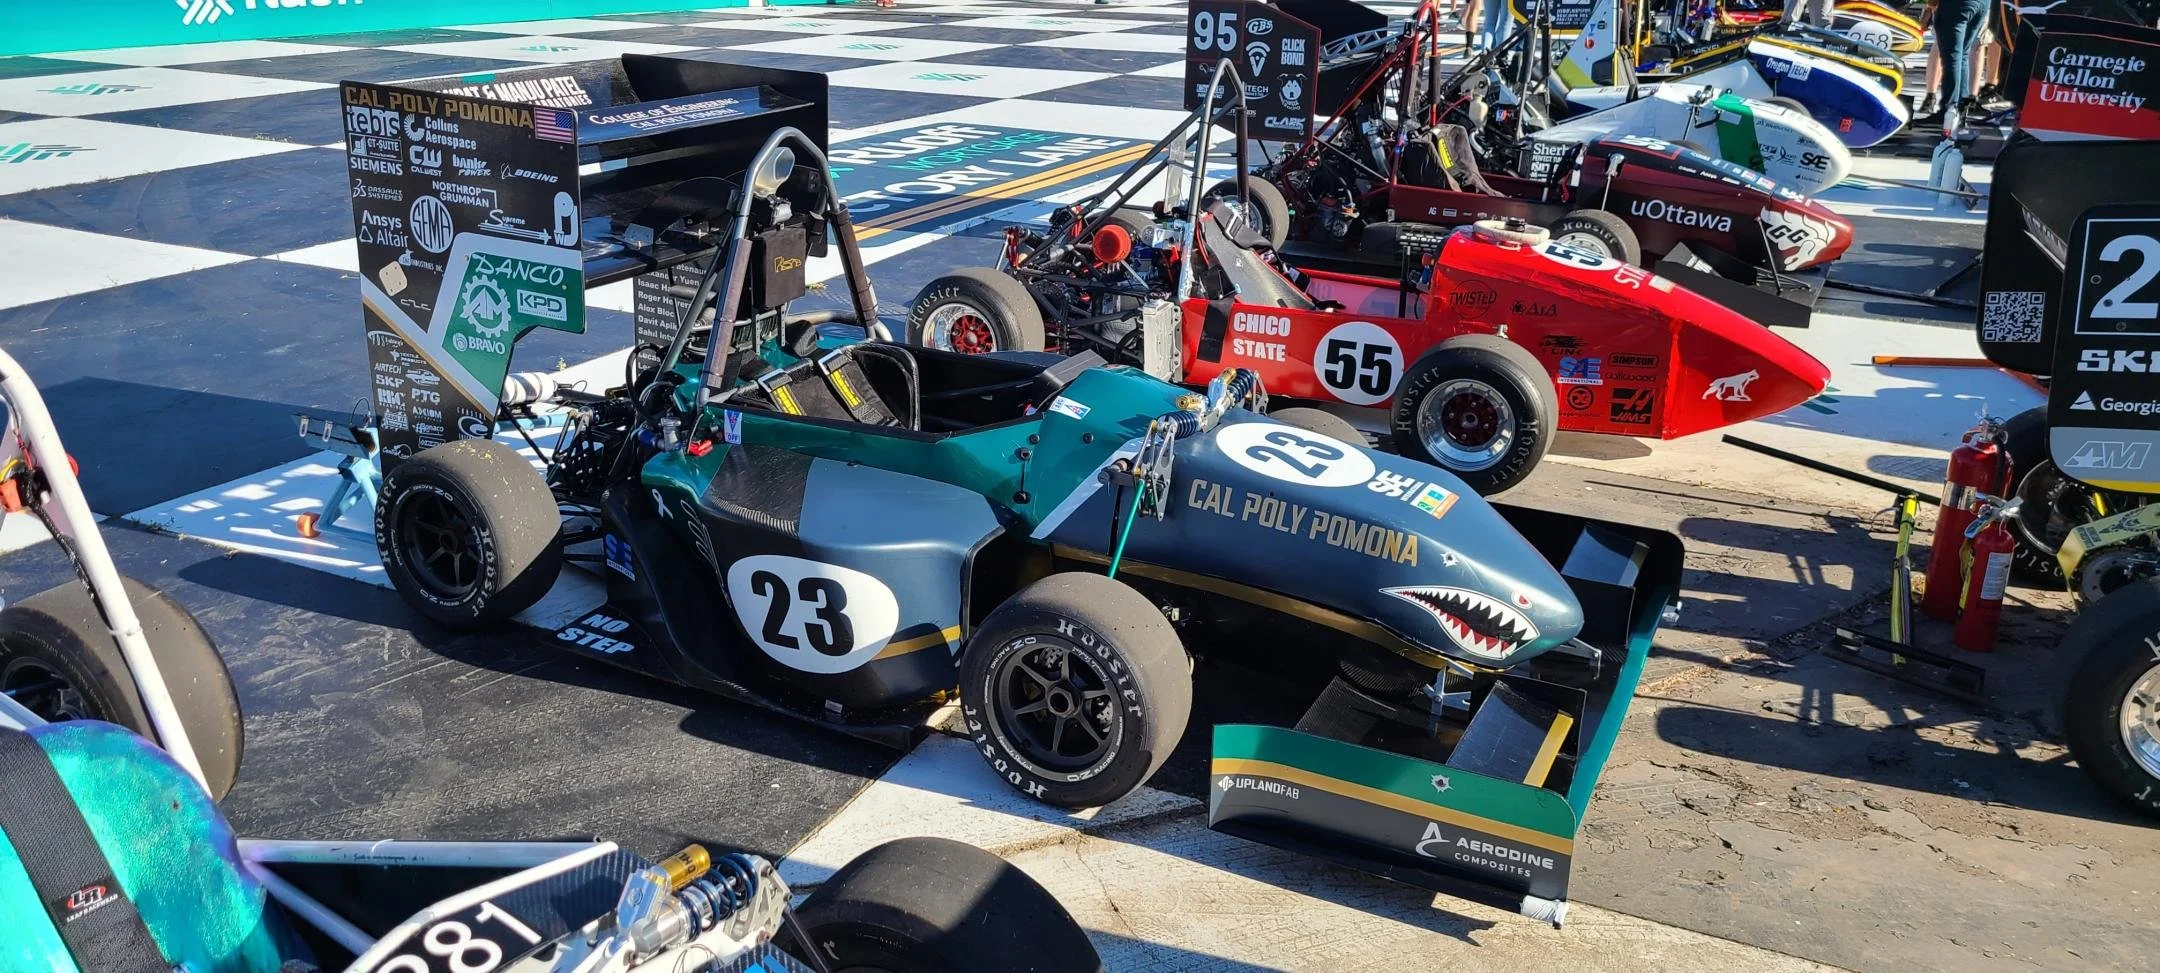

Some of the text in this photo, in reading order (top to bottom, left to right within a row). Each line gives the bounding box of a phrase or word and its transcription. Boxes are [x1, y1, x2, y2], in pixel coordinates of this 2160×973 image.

[1194, 11, 1238, 51] 95
[1282, 38, 1305, 51] CLICK
[1281, 52, 1305, 65] BOND
[1766, 57, 1809, 79] Oregon TECH
[2049, 46, 2146, 75] Carnegie
[541, 76, 586, 99] PATEL
[2043, 65, 2115, 89] Mellon
[345, 87, 384, 108] CAL
[390, 92, 439, 115] POLY
[444, 100, 534, 129] POMONA
[2040, 83, 2146, 113] University
[347, 106, 400, 136] tebis
[425, 117, 459, 133] Collins
[426, 130, 476, 150] Aerospace
[828, 125, 1002, 165] RUOFF
[888, 132, 1060, 171] MORTGAGE
[990, 138, 1131, 168] LANE
[1800, 152, 1831, 171] SAE
[351, 157, 403, 175] SIEMENS
[514, 169, 558, 183] BOEING
[433, 180, 482, 196] NORTHROP
[440, 192, 489, 208] GRUMMAN
[362, 210, 402, 230] Ansys
[412, 198, 451, 249] SEMA
[1631, 199, 1732, 232] uOttawa
[377, 228, 408, 248] Altair
[473, 253, 564, 287] DANCO
[679, 275, 700, 286] Yuen
[2090, 234, 2160, 319] 2
[638, 279, 659, 289] Isaac
[520, 293, 562, 312] KPD
[638, 291, 661, 302] Roger
[910, 285, 960, 330] Hoosier
[1450, 290, 1498, 306] TWISTED
[1234, 313, 1291, 337] CHICO
[468, 336, 505, 354] BRAVO
[1234, 338, 1286, 362] STATE
[374, 362, 402, 374] AIRTECH
[1324, 339, 1393, 397] 55
[1559, 357, 1602, 379] SAE
[1612, 354, 1656, 367] SIMPSON
[375, 374, 405, 388] SKF
[411, 388, 441, 404] PTG
[1246, 431, 1345, 478] 23
[1188, 479, 1418, 567] CAL POLY POMONA
[580, 612, 631, 634] NO
[750, 569, 856, 657] 23
[555, 627, 635, 656] STEP
[1056, 618, 1143, 718] Hoosier
[1067, 751, 1116, 783] OZ RACING
[1235, 776, 1300, 800] UPLANDFAB
[1454, 852, 1532, 878] COMPOSITES
[1456, 836, 1554, 870] AERODINE
[376, 901, 542, 973] 81
